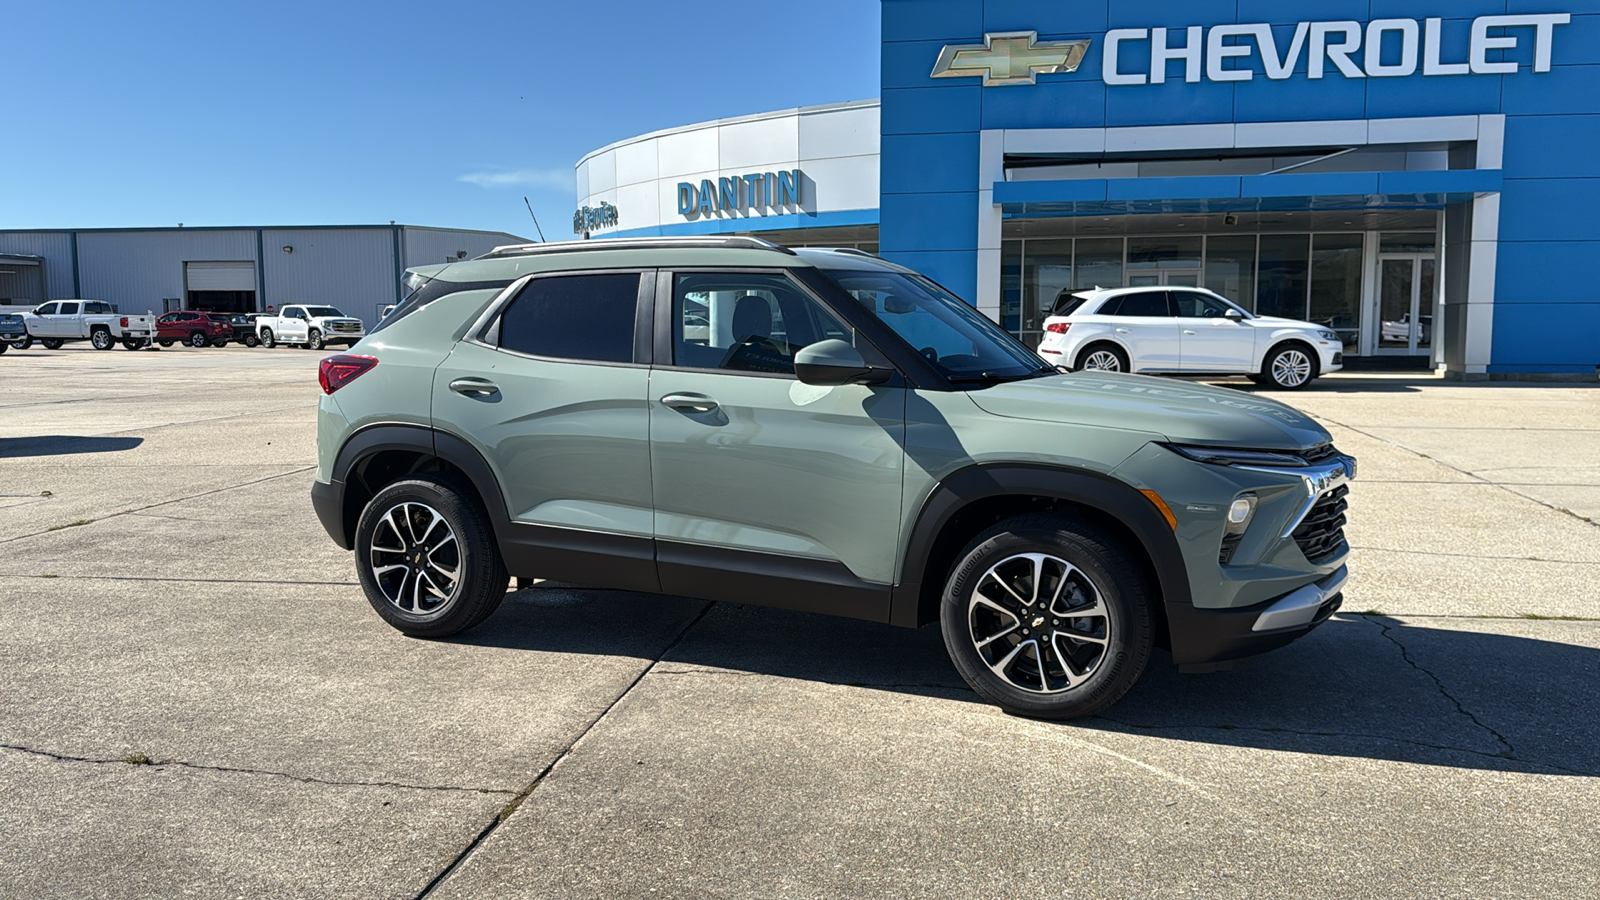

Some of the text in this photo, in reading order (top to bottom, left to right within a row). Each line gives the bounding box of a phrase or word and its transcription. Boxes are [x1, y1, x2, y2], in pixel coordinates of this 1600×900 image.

[1102, 13, 1571, 85] CHEVROLET
[677, 169, 800, 215] DANTIN
[951, 549, 985, 597] Continental
